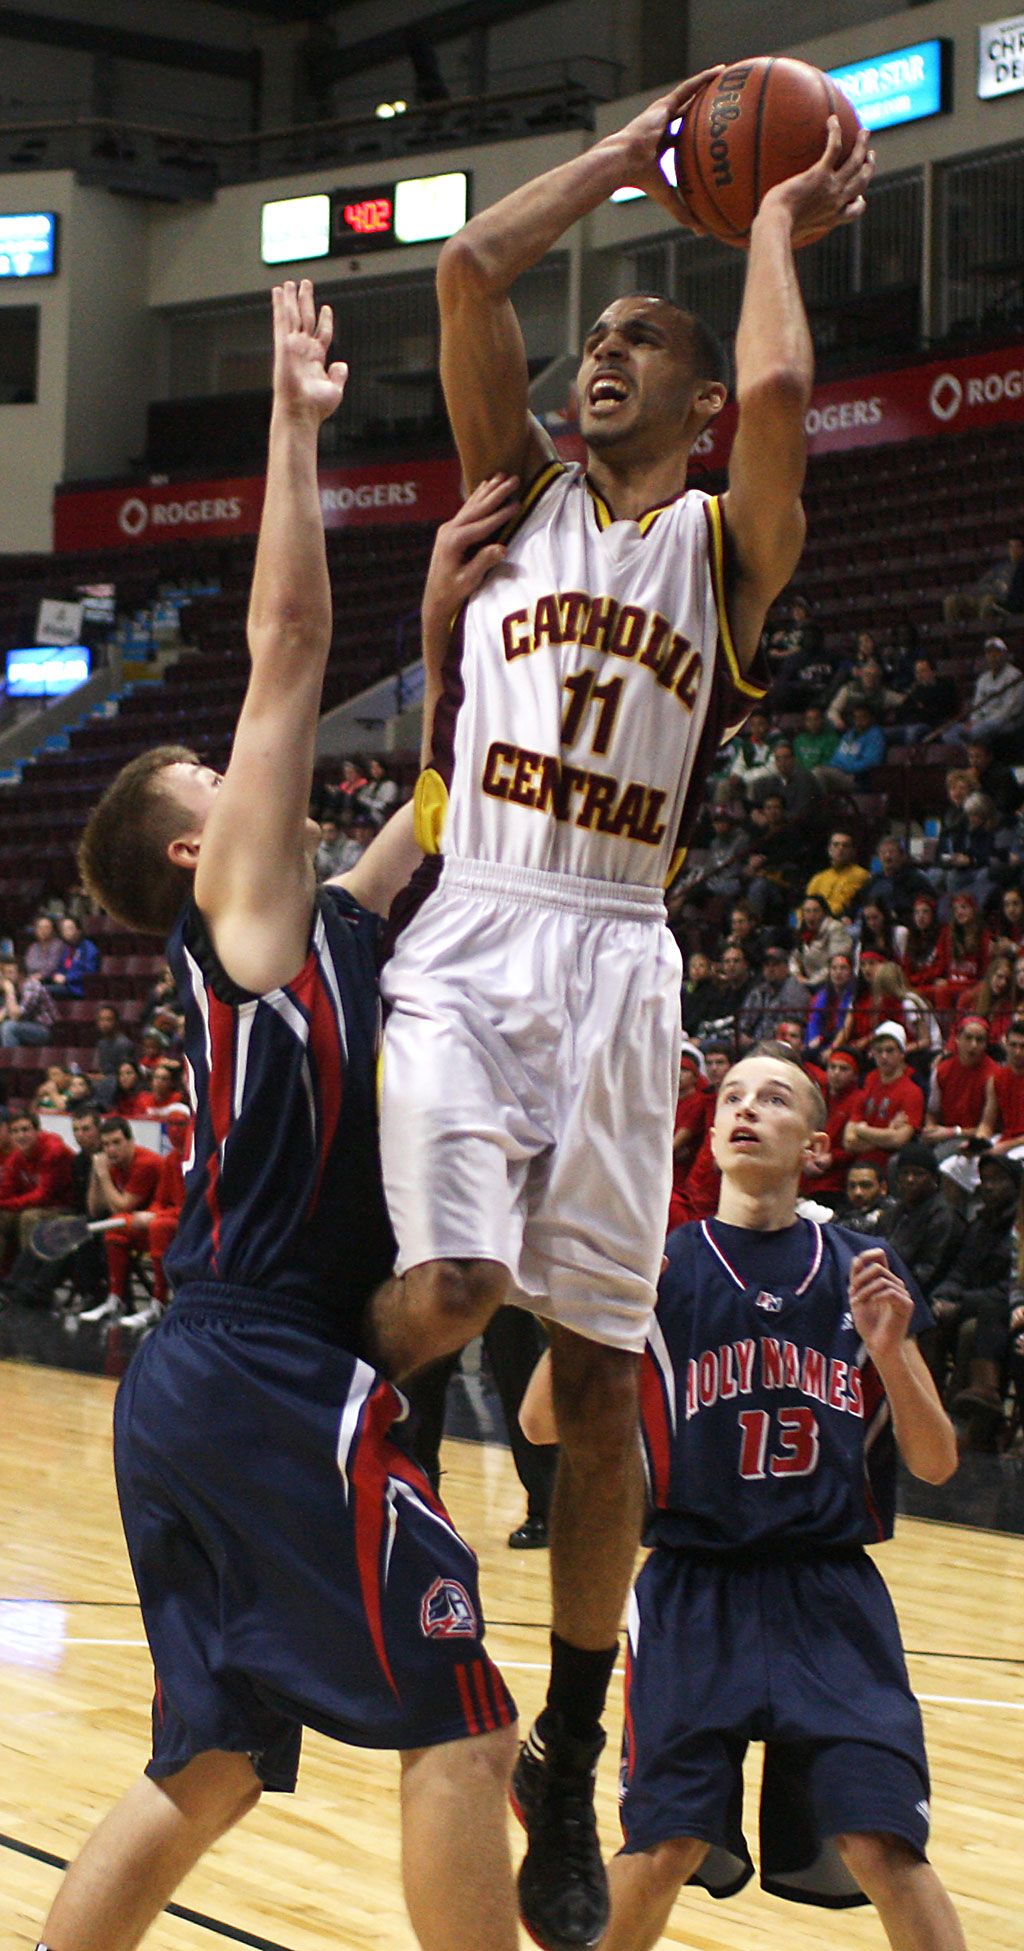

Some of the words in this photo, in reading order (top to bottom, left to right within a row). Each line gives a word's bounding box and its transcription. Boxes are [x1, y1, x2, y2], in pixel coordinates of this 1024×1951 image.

[709, 65, 753, 188] Wilson
[804, 397, 882, 436] OGERS
[966, 370, 1024, 405] ROG
[153, 497, 241, 525] ROGERS
[321, 482, 417, 511] ROGERS
[501, 589, 703, 714] CATHOLIC
[560, 669, 626, 758] 11
[482, 741, 667, 846] CENTRAL
[760, 1336, 865, 1418] NAMES
[738, 1406, 820, 1480] 13
